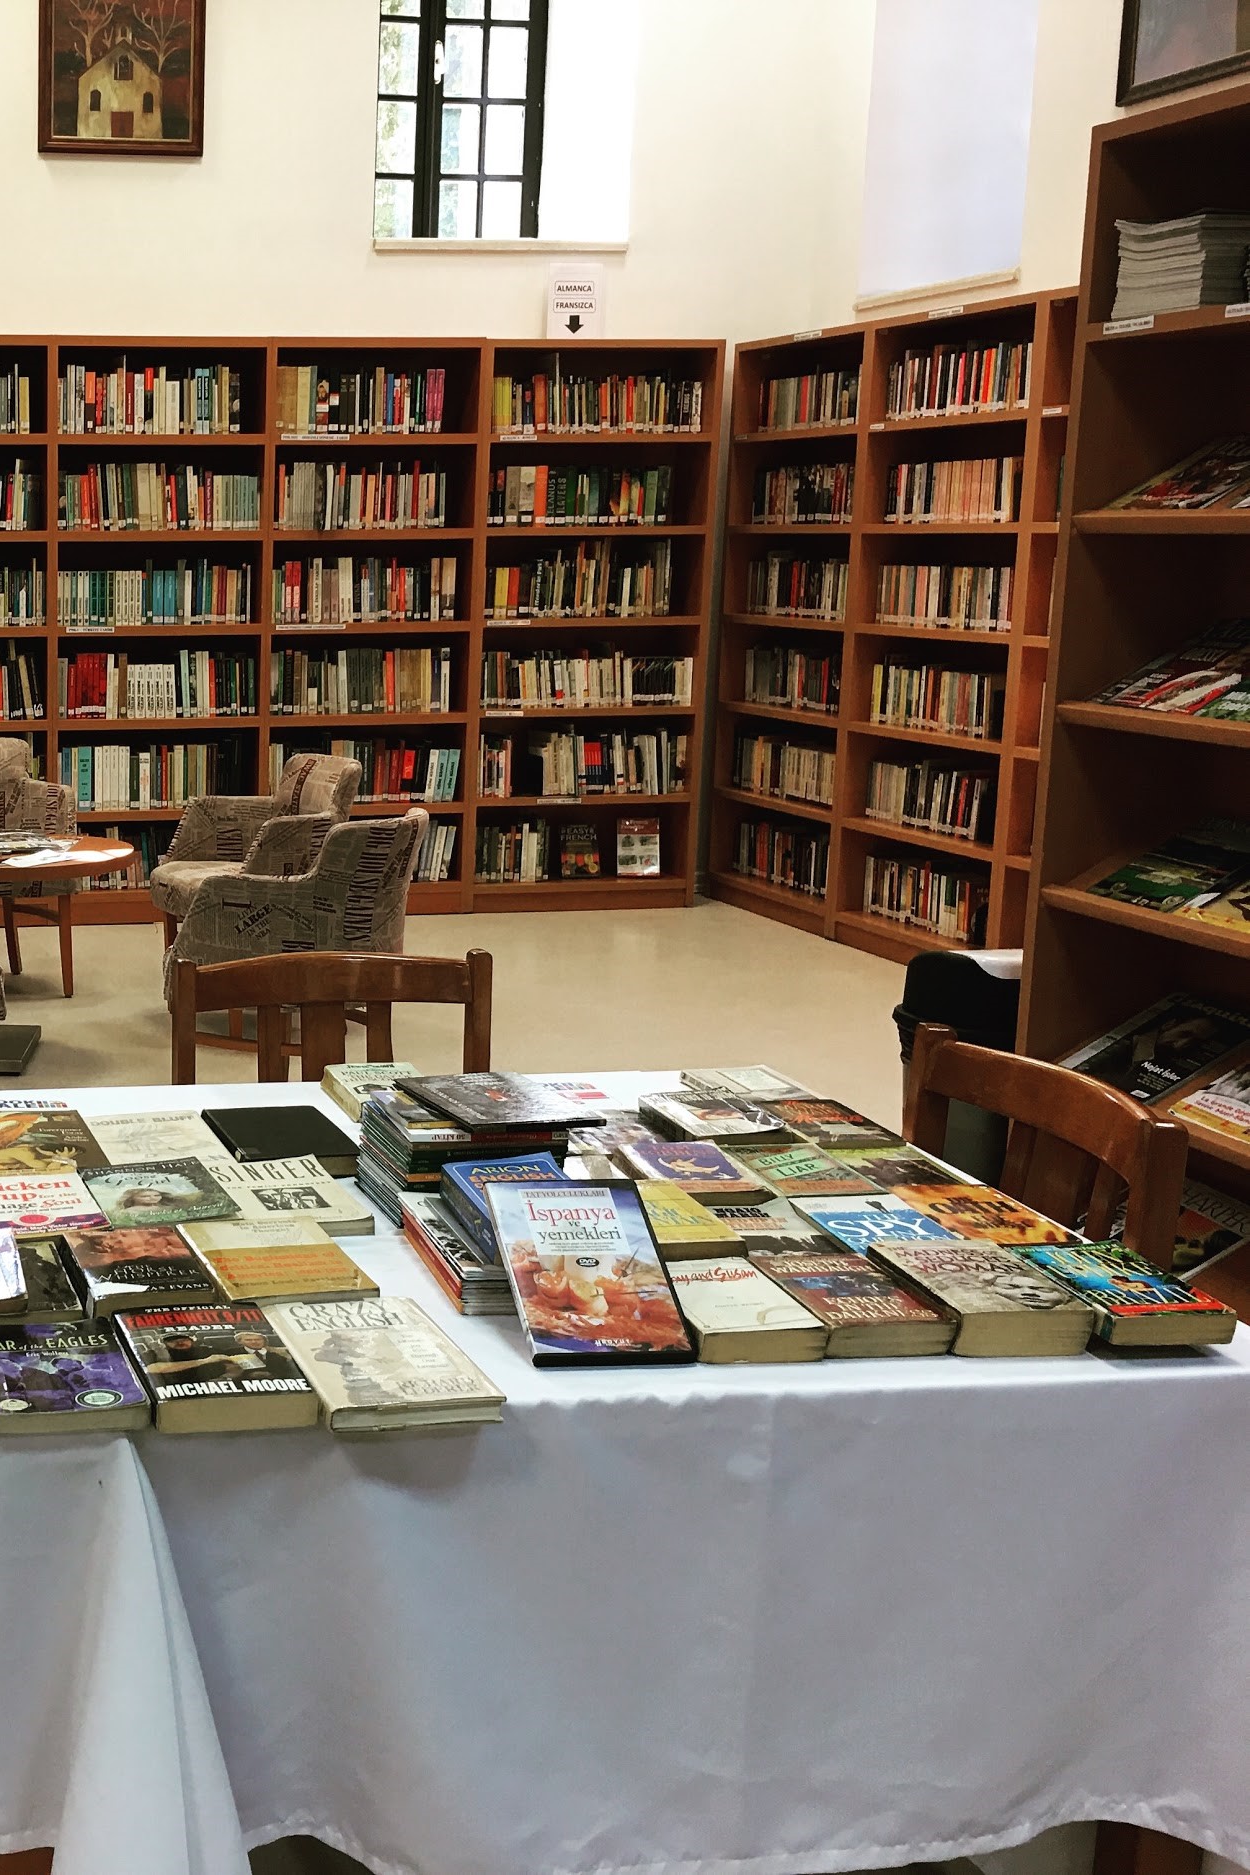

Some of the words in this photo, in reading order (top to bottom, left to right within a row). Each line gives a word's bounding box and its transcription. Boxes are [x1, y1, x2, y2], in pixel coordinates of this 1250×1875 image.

[560, 833, 597, 841] FRENCH
[234, 904, 274, 935] LARGE
[343, 894, 375, 942] GAINES
[255, 919, 272, 932] THE
[255, 928, 272, 941] NBA
[89, 1117, 147, 1127] DOUBLE
[151, 1114, 195, 1123] BLUFF
[758, 1153, 795, 1166] BILLY
[87, 1165, 156, 1176] SHANNON
[208, 1158, 326, 1183] SINGER
[471, 1164, 541, 1175] ARION
[776, 1163, 819, 1177] LIAR
[467, 1171, 557, 1183] ENGLISH
[41, 1197, 83, 1208] Soul
[928, 1200, 1019, 1215] OATH
[524, 1199, 616, 1227] İspanya
[568, 1220, 581, 1228] ve
[827, 1218, 932, 1239] SPY
[536, 1227, 622, 1245] yemekleri
[915, 1261, 1025, 1273] WOMAN
[690, 1268, 714, 1281] and
[714, 1266, 759, 1282] Susan
[172, 1282, 210, 1291] EVANS
[144, 1307, 171, 1315] THE
[172, 1304, 231, 1312] OFFICIAL
[289, 1300, 389, 1318] CRAZY
[124, 1310, 222, 1329] FAHRENHEIT
[222, 1309, 263, 1324] 9/11
[294, 1311, 405, 1332] ENGLISH
[163, 1324, 236, 1333] READER
[19, 1344, 29, 1352] of
[30, 1342, 45, 1350] the
[45, 1334, 109, 1349] EAGLES
[155, 1380, 243, 1401] MICHAEL
[242, 1377, 312, 1392] MOORE
